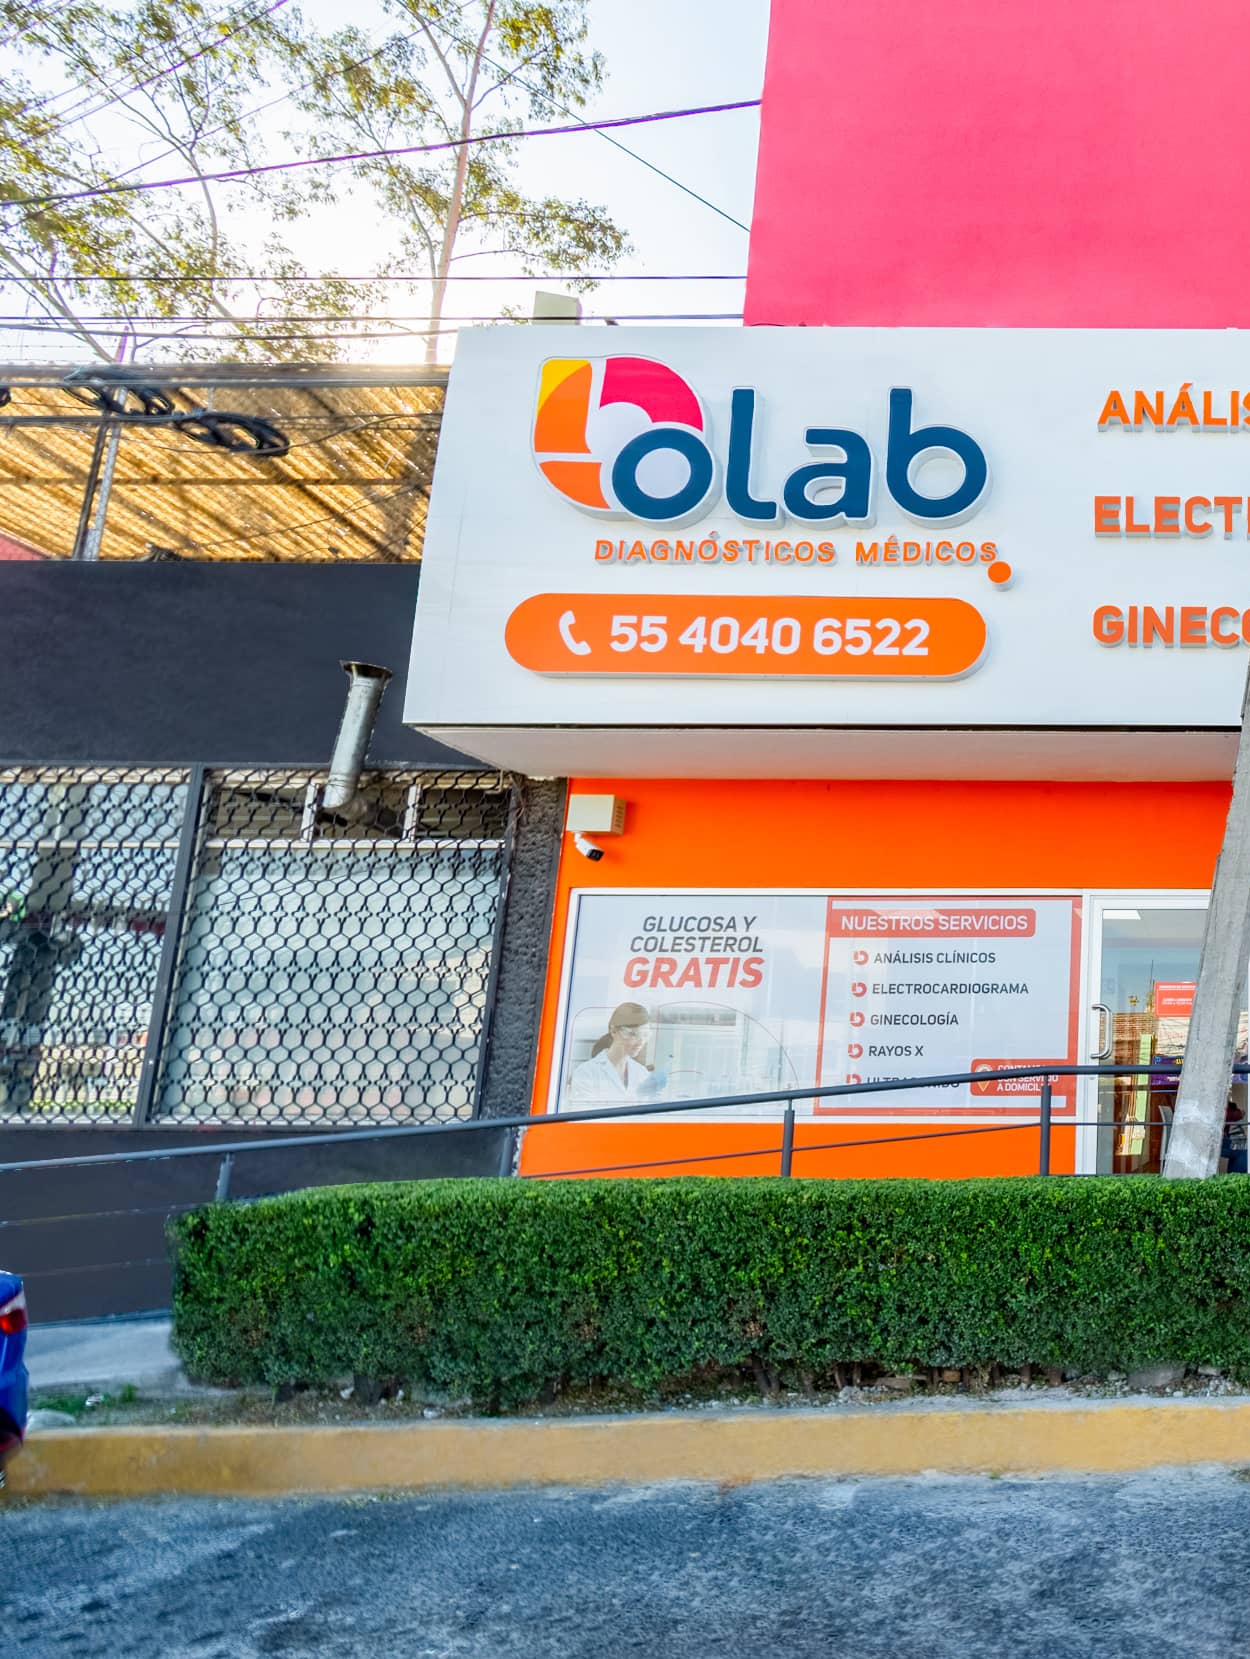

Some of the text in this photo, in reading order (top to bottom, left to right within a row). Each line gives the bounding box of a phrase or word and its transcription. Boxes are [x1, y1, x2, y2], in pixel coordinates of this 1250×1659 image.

[595, 531, 997, 563] DIAGNÓSTICOS MÉDICOS
[609, 616, 930, 656] 55 4040 6522
[643, 916, 757, 933] GLUCOSA Y
[841, 915, 1028, 932] NUESTROS SERVICIOS
[630, 936, 764, 953] COLESTEROL
[874, 949, 996, 964] ANÁLISIS CLÍNICOS
[623, 957, 765, 988] GRATIS
[872, 982, 1029, 995] ELECTROCARDIOGRAMA
[870, 1011, 959, 1026] GINECOLOGÍA
[868, 1045, 924, 1057] RAYOS X
[997, 1083, 1004, 1091] A
